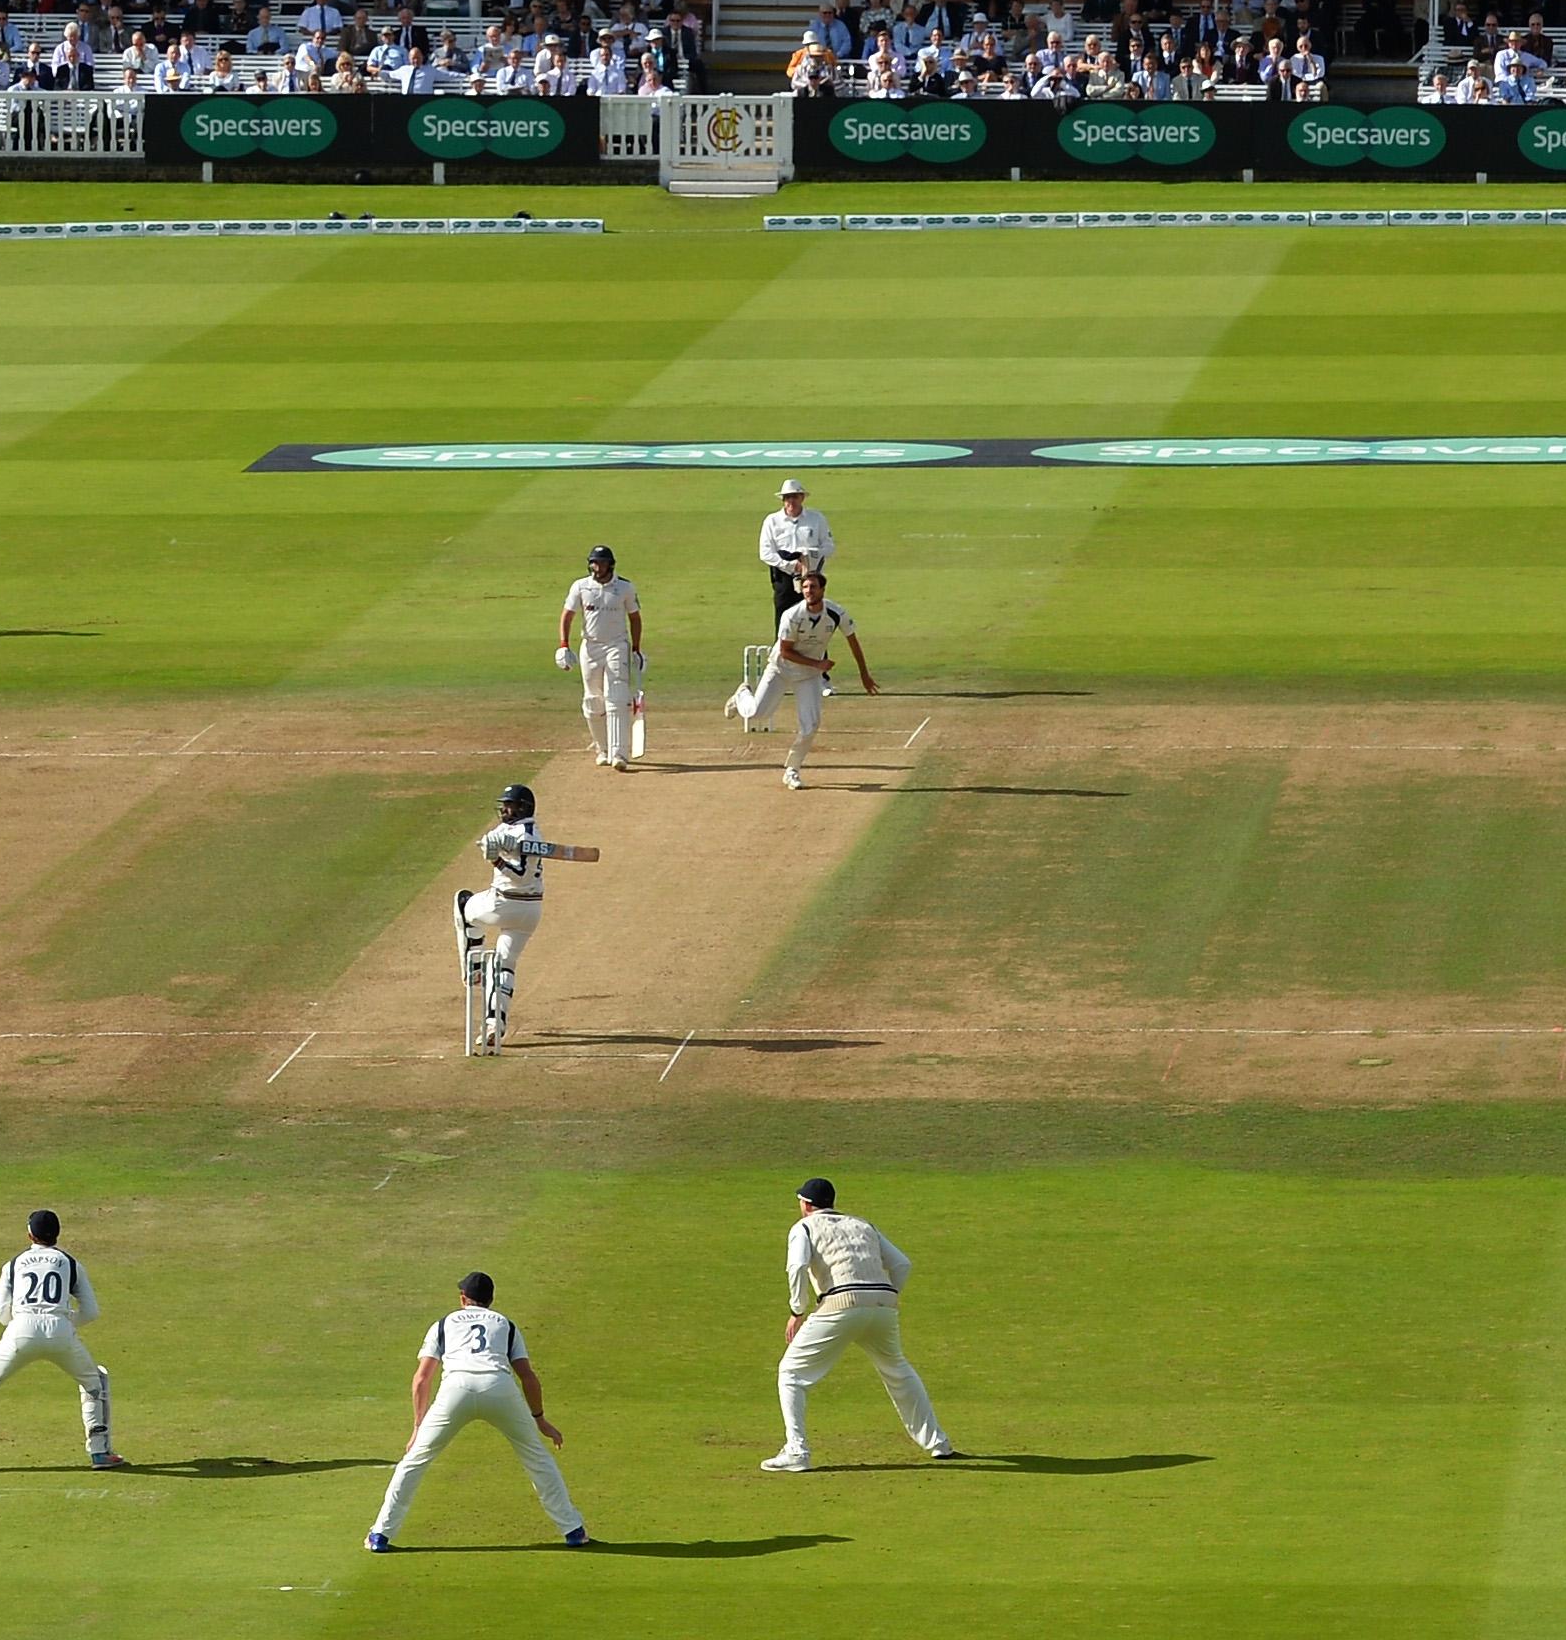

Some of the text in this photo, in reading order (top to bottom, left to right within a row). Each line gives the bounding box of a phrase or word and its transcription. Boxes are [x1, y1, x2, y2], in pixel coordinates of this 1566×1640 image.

[195, 113, 322, 141] Specsavers
[423, 114, 550, 142] Specsavers
[844, 117, 972, 145] Specsavers
[1073, 119, 1200, 147] Specsavers
[1303, 121, 1431, 149] Specsavers
[377, 448, 908, 463] Specsavers
[522, 841, 549, 855] BAS
[21, 1256, 65, 1269] SIMPSON
[21, 1271, 63, 1305] 20
[470, 1324, 487, 1354] 3
